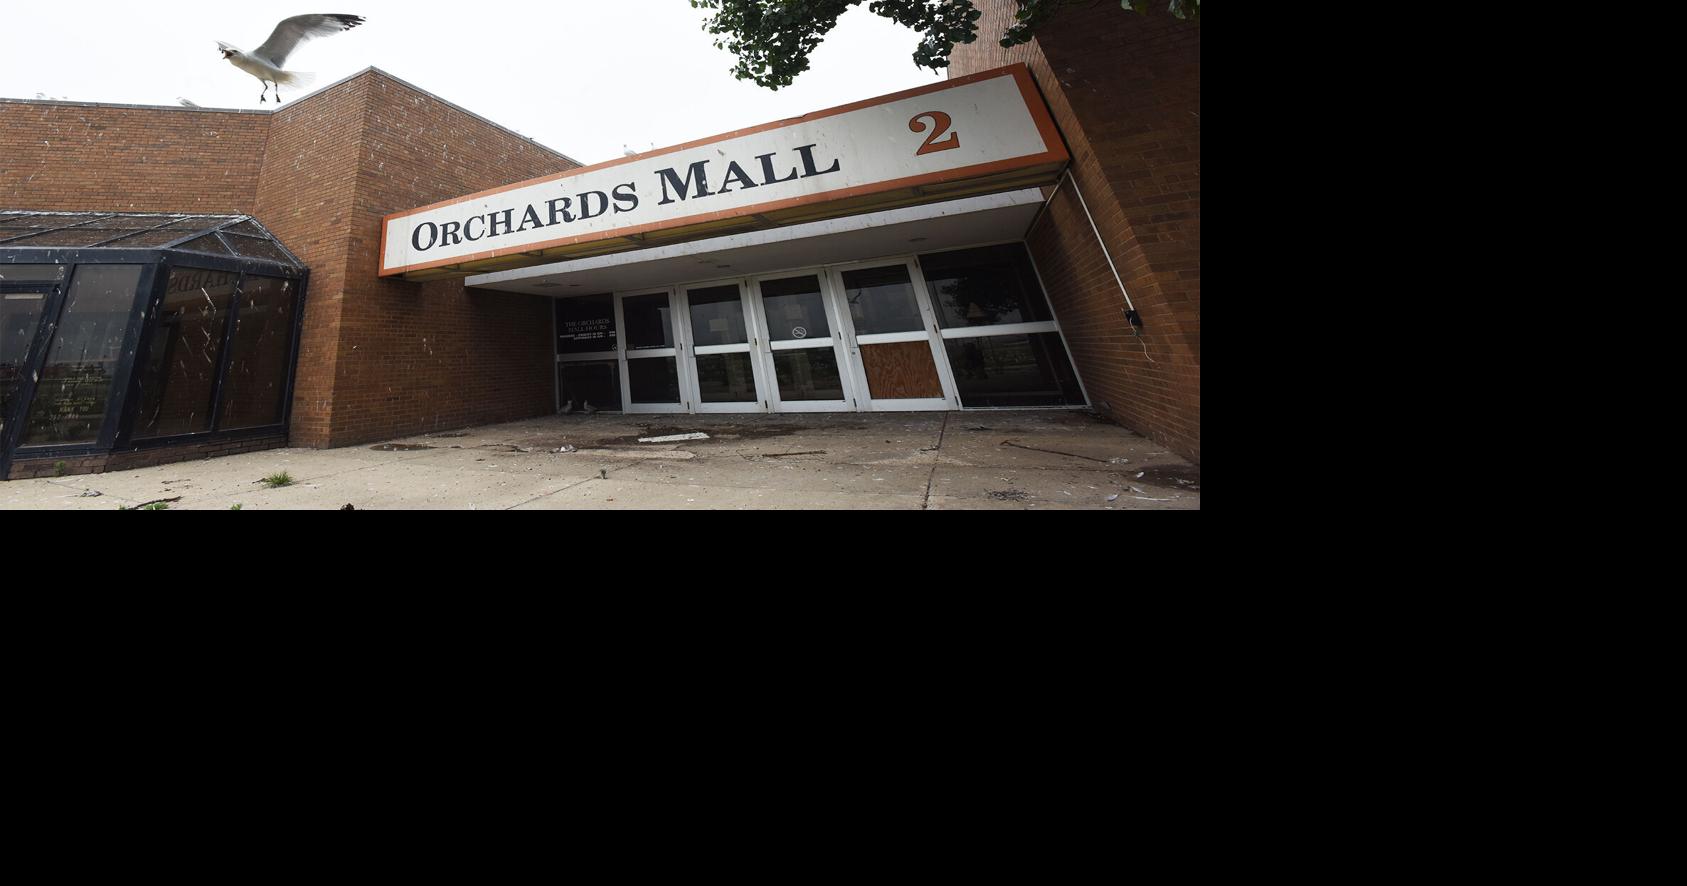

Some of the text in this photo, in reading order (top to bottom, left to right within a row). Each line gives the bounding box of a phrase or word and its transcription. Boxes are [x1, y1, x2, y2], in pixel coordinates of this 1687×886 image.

[411, 110, 961, 251] ORCHARDS MALL 2
